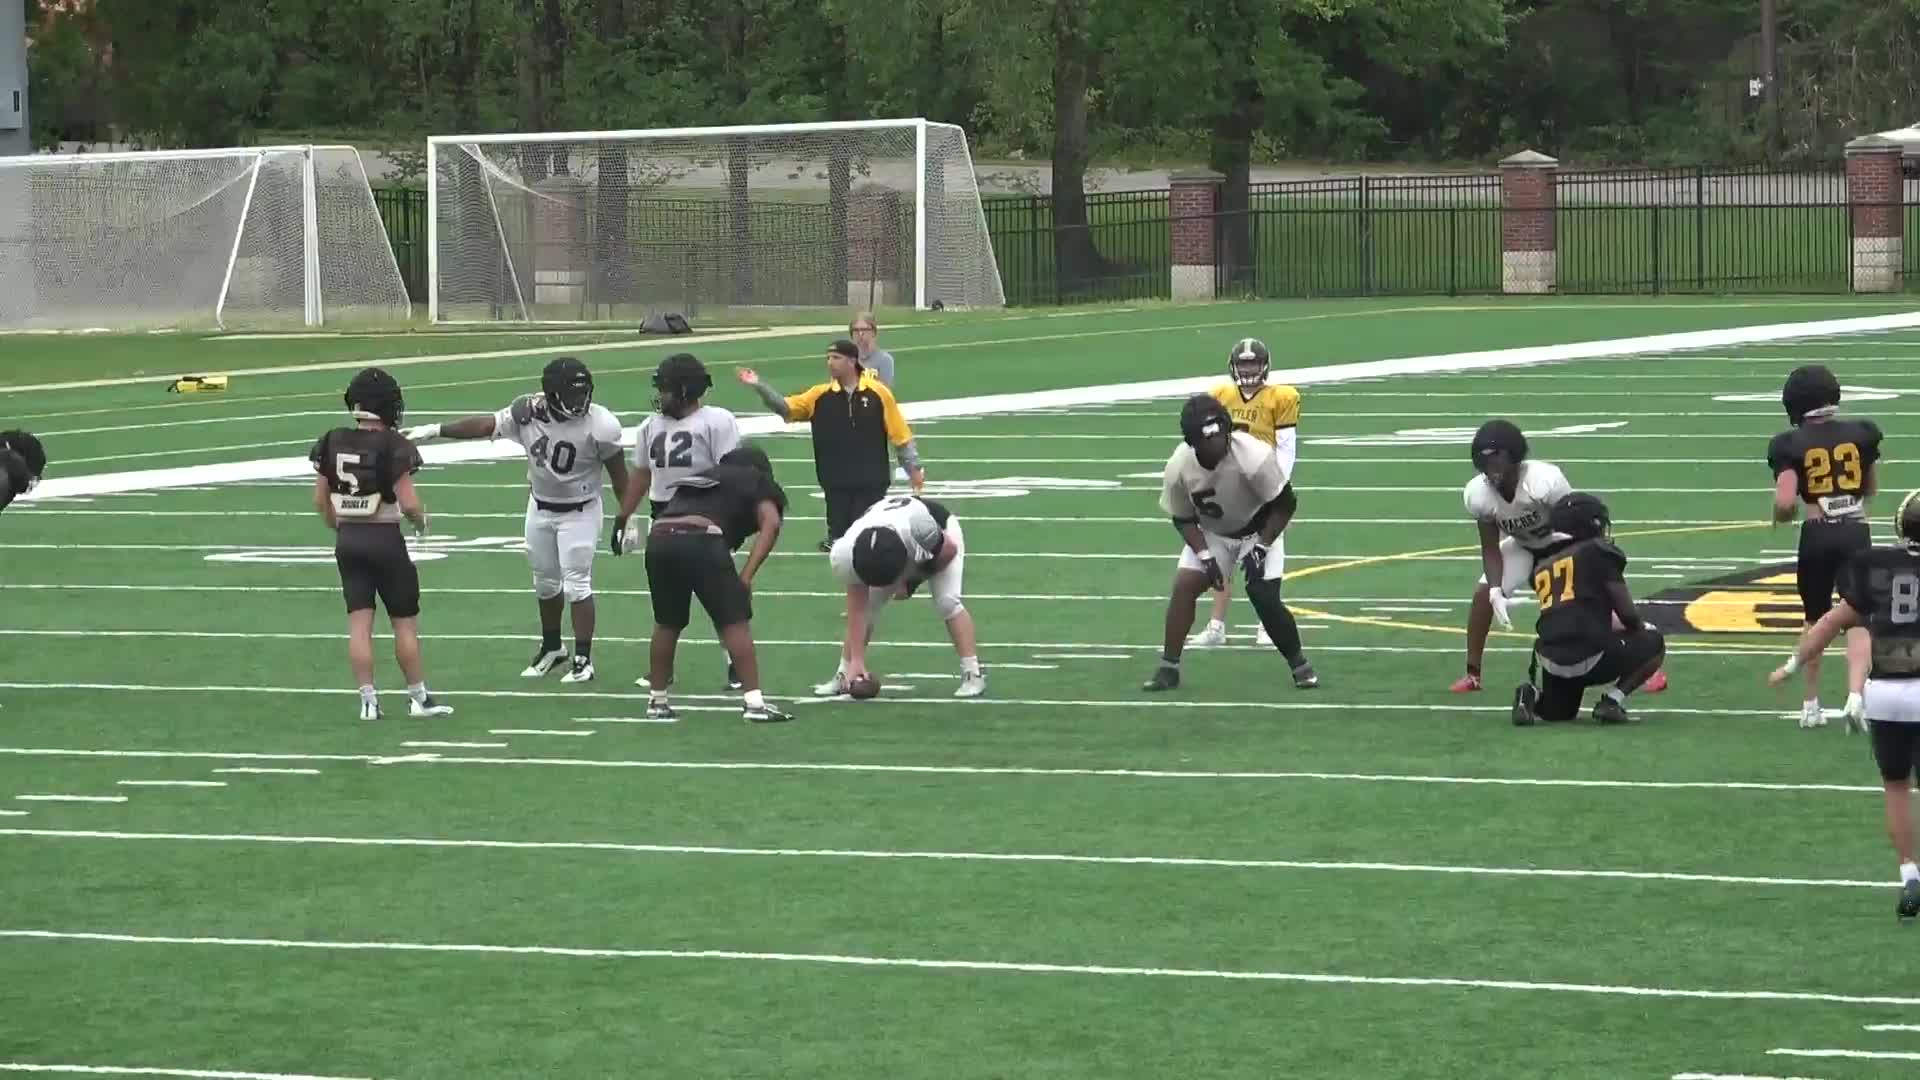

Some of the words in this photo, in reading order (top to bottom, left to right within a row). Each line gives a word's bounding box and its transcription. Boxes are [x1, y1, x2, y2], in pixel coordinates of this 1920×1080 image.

[530, 434, 577, 474] 40
[650, 431, 692, 468] 42
[1804, 442, 1862, 494] 23
[336, 453, 360, 496] 5
[340, 499, 370, 510] DOUGLAS
[1191, 487, 1224, 519] 5
[1535, 556, 1575, 610] 27
[1891, 575, 1919, 623] 8
